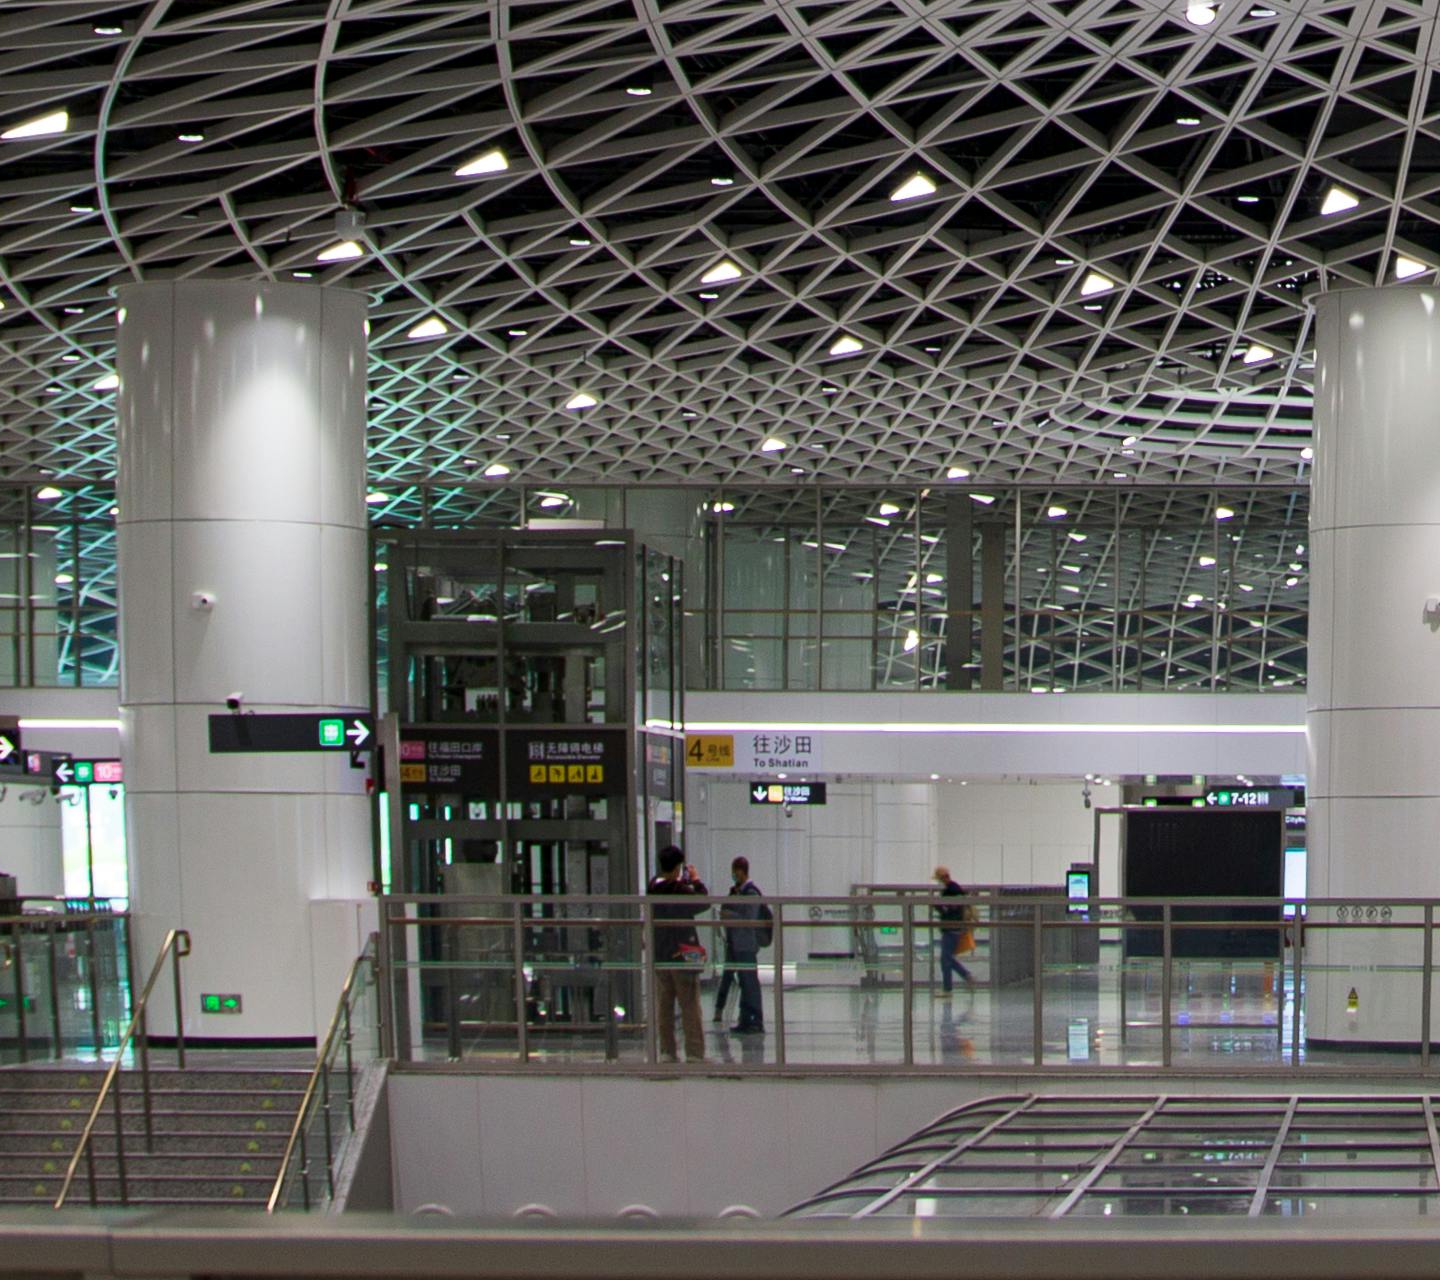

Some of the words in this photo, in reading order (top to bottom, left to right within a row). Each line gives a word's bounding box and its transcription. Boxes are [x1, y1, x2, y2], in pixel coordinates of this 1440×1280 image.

[753, 735, 812, 755] 往沙田
[754, 759, 766, 768] To
[768, 758, 809, 768] Shatian
[1231, 792, 1257, 805] 7-12
